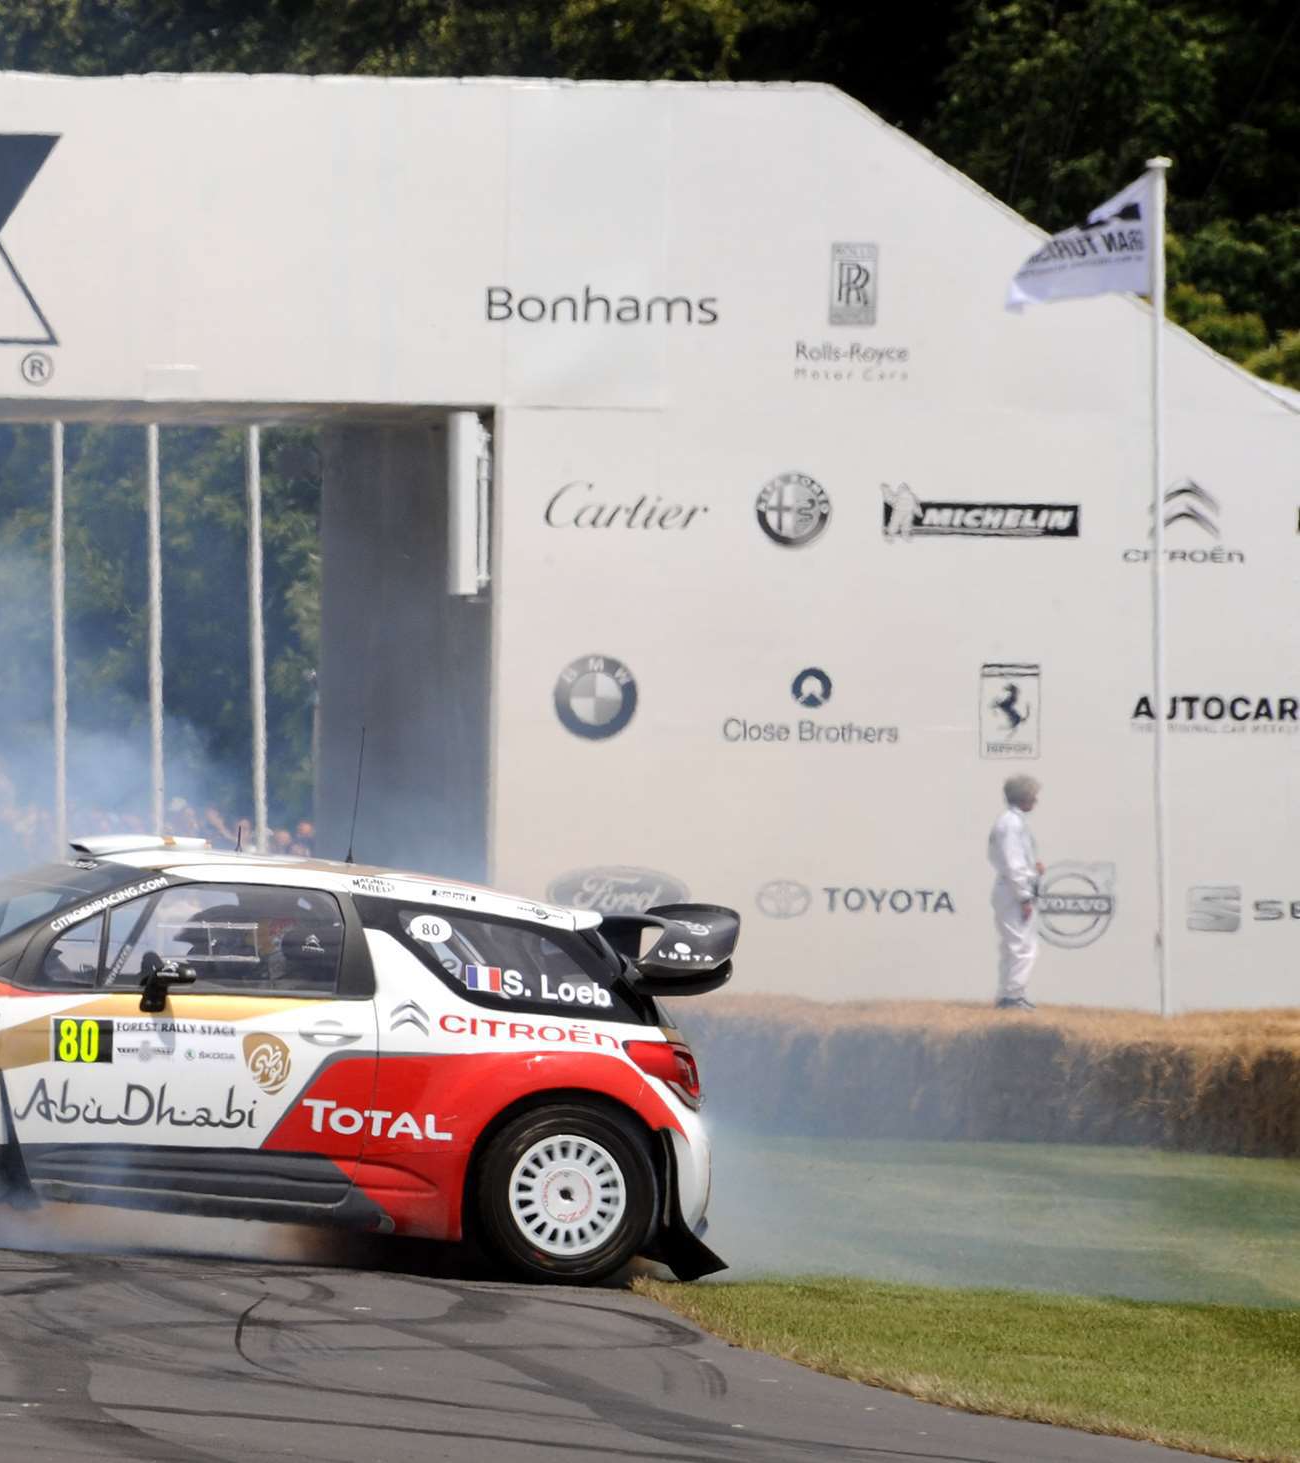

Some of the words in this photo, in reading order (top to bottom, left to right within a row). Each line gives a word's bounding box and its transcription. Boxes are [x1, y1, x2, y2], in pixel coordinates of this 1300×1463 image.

[486, 285, 719, 325] Bonhams
[795, 341, 910, 365] Rolls-Royce
[544, 480, 709, 531] Cartier
[922, 508, 1075, 531] MICHELIN
[723, 718, 791, 742] Close
[799, 720, 900, 744] Brothers
[822, 886, 957, 914] TOYOTA
[1038, 898, 1109, 911] VOLVO
[421, 922, 440, 937] 80
[502, 969, 531, 997] S.
[541, 973, 612, 1008] Loeb
[58, 1019, 100, 1063] 80
[116, 1022, 157, 1032] FOREST
[161, 1022, 197, 1034] RALLY
[200, 1025, 237, 1037] STAGE
[303, 1098, 453, 1141] TOTAL
